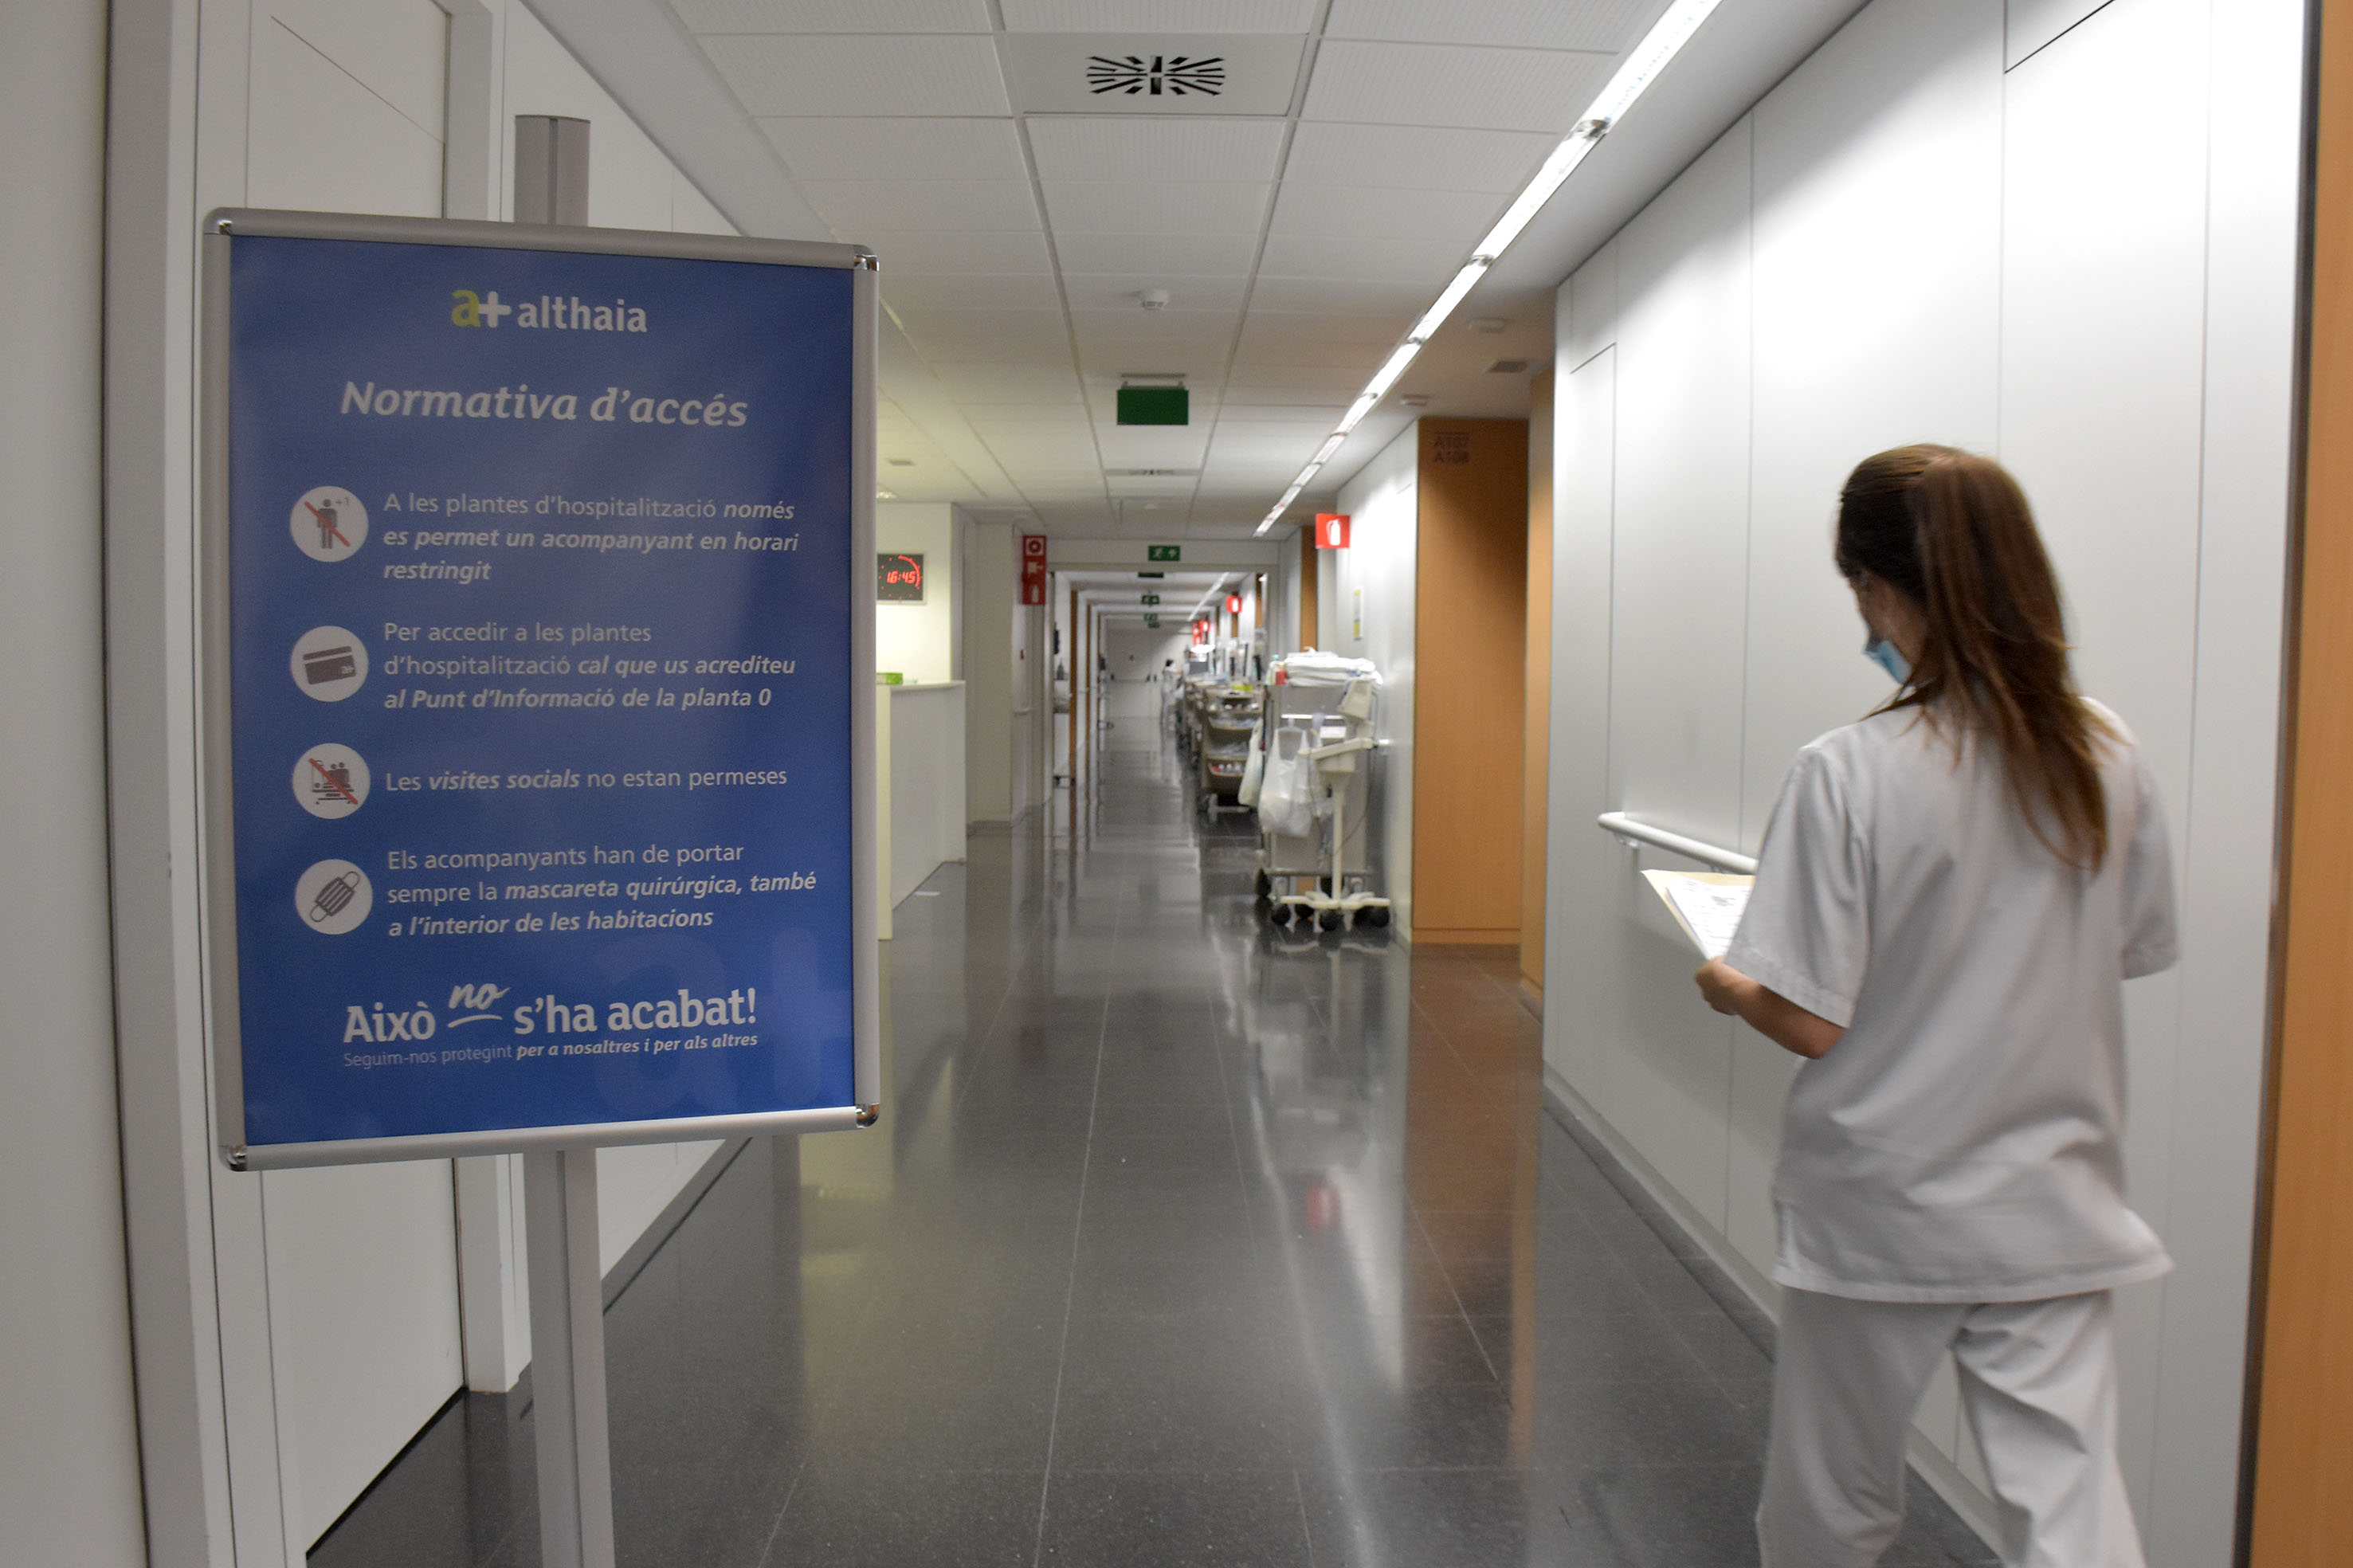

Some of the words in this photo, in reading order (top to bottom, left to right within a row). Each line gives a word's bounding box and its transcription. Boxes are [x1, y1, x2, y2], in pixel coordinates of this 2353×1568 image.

[517, 295, 648, 333] althaia
[340, 381, 578, 421] Normativa
[590, 386, 748, 427] d'accés
[383, 492, 402, 512] A
[409, 492, 439, 512] les
[445, 492, 529, 517] plantes
[535, 495, 716, 520] d'hospitalització
[723, 500, 795, 519] només
[382, 531, 409, 546] es
[414, 529, 500, 551] permet
[505, 532, 535, 547] un
[541, 533, 695, 555] acompanyant
[699, 535, 727, 550] en
[733, 531, 800, 551] horari
[383, 560, 492, 585] restringit
[886, 570, 916, 584] 16:45
[384, 622, 422, 641] Per
[427, 621, 508, 641] accedir
[514, 627, 527, 641] a
[535, 621, 565, 642] les
[571, 622, 652, 646] plantes
[383, 655, 571, 680] d'hospitalització
[578, 654, 610, 675] cal
[614, 660, 657, 679] que
[664, 660, 689, 675] us
[694, 655, 796, 674] acrediteu
[383, 688, 406, 709] al
[411, 689, 467, 708] Punt
[472, 688, 615, 708] d'Informació
[622, 688, 650, 708] de
[656, 687, 676, 707] la
[680, 687, 752, 711] planta
[758, 688, 772, 707] 0
[386, 773, 422, 791] Les
[429, 770, 500, 790] visites
[506, 768, 581, 790] socials
[587, 773, 616, 788] no
[622, 770, 681, 787] estan
[688, 770, 787, 791] permeses
[387, 849, 418, 870] Els
[424, 848, 587, 872] acompanyants
[594, 845, 635, 864] han
[641, 844, 670, 864] de
[676, 845, 744, 867] portar
[387, 887, 471, 907] sempre
[478, 881, 497, 901] la
[504, 880, 619, 900] mascareta
[626, 875, 742, 901] quirúrgica,
[750, 871, 817, 892] també
[388, 922, 402, 937] a
[409, 915, 510, 936] l'interior
[515, 912, 543, 933] de
[549, 911, 581, 931] les
[586, 908, 714, 930] habitacions
[343, 1001, 436, 1044] Això
[448, 982, 510, 1010] no
[514, 994, 598, 1035] s'ha
[607, 987, 756, 1031] acabat!
[343, 1050, 437, 1070] Seguim-nos
[441, 1046, 512, 1065] protegint
[516, 1045, 545, 1061] per
[547, 1045, 559, 1056] a
[563, 1040, 640, 1056] nosaltres
[653, 1040, 681, 1055] per
[684, 1035, 708, 1050] als
[711, 1033, 758, 1049] altres
